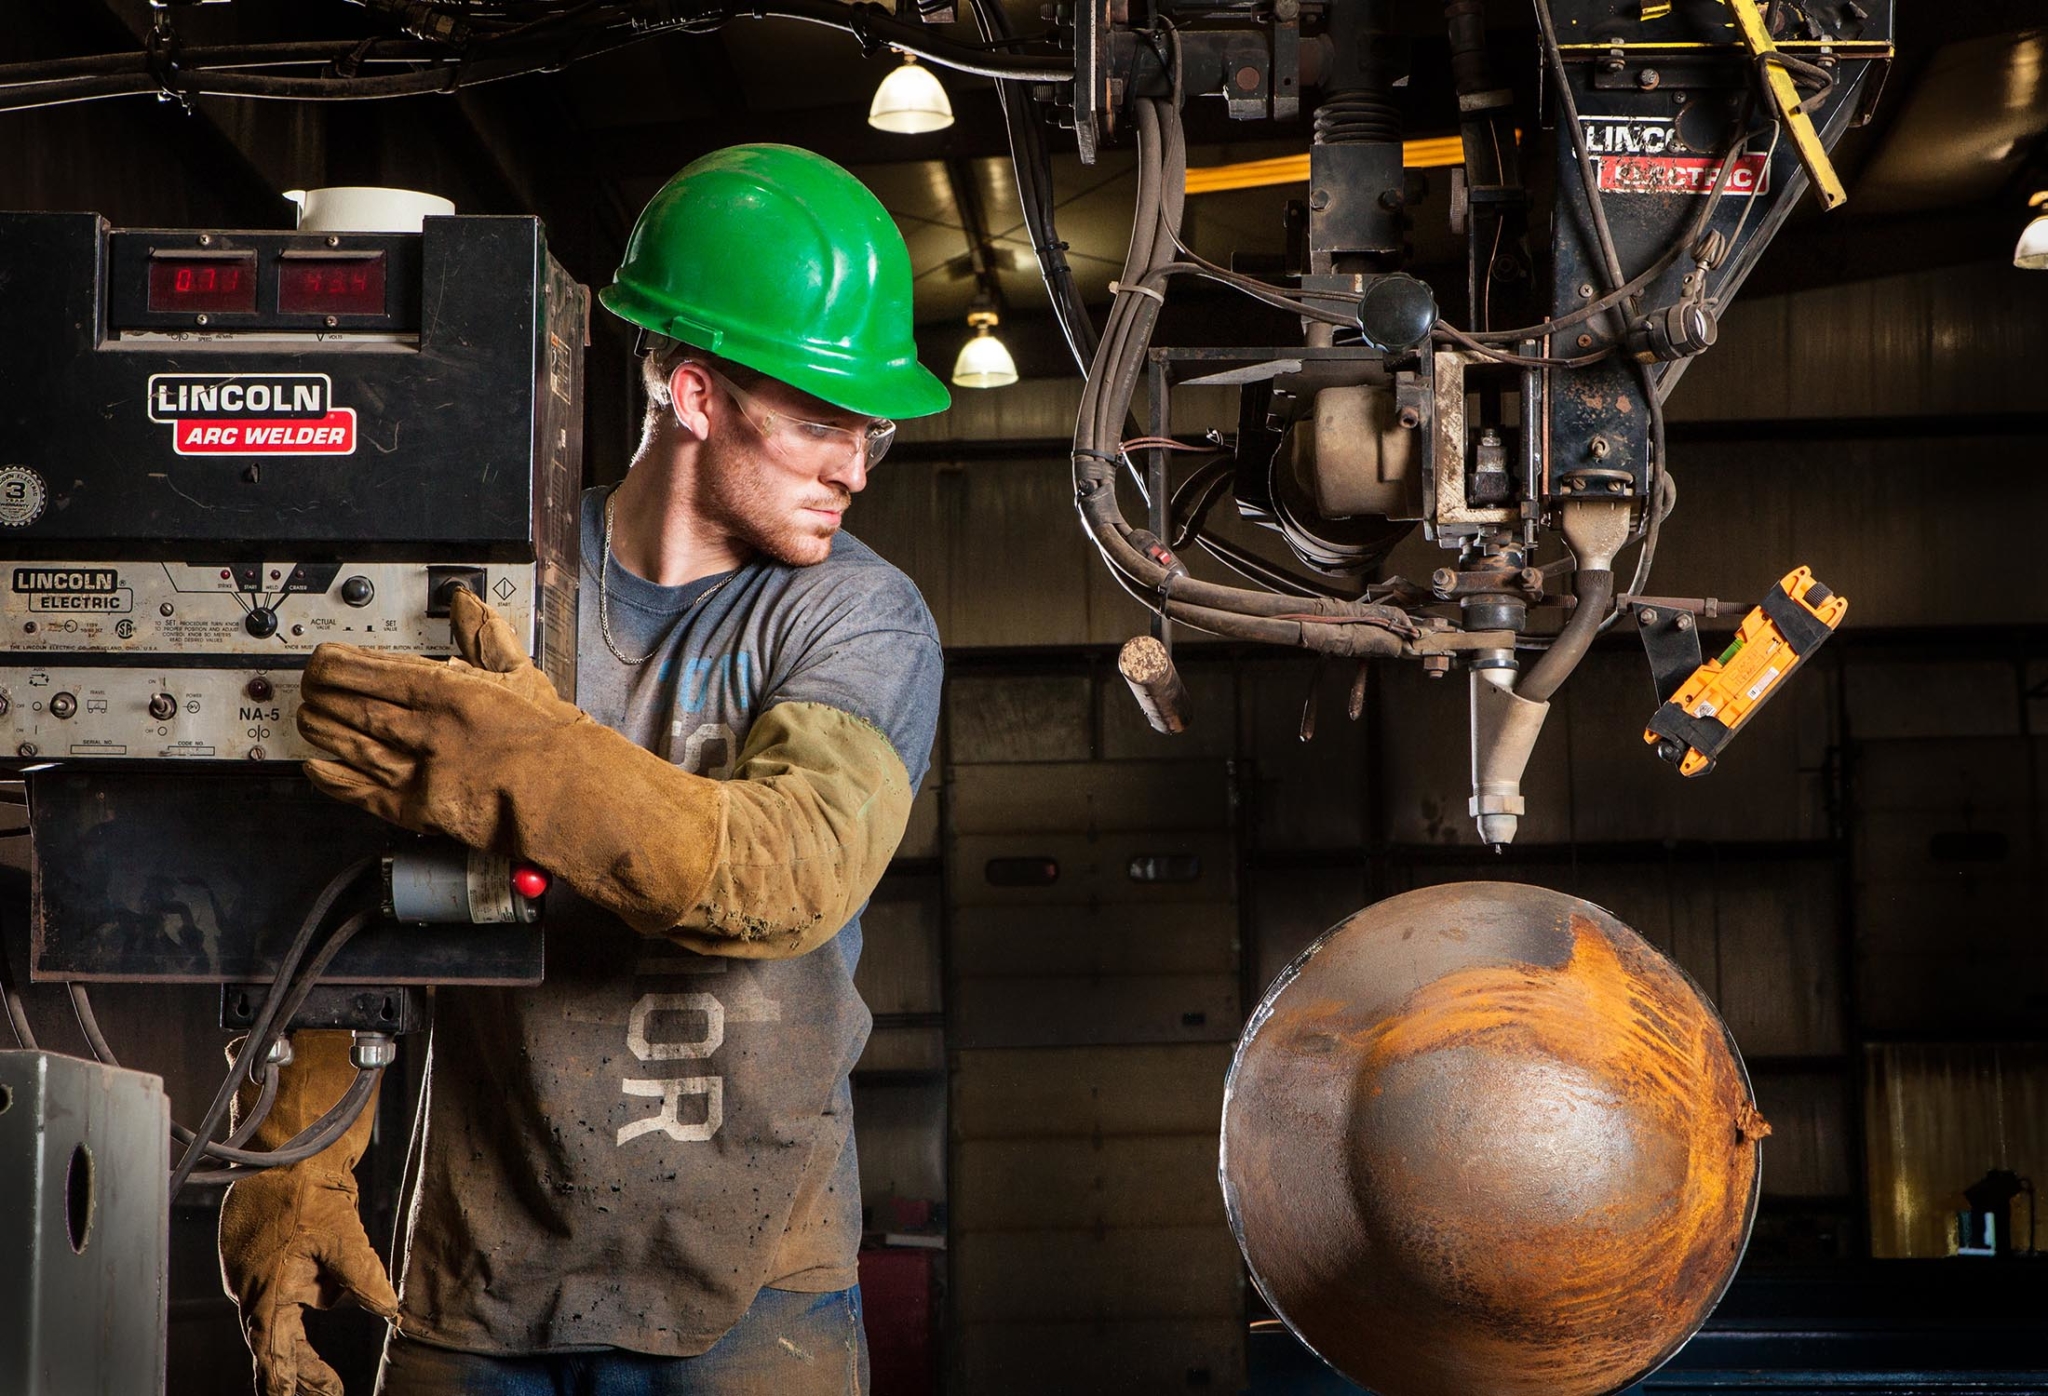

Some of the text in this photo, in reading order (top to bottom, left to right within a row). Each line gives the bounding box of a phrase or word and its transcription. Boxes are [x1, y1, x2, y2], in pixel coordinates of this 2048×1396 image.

[1586, 125, 1687, 153] LINC
[158, 385, 320, 412] LINCOLN
[184, 427, 346, 445] ARC WELDER
[6, 481, 26, 499] 3
[18, 572, 112, 590] LINCOLN
[41, 596, 120, 608] ELECTRIC
[385, 619, 397, 627] SET
[240, 707, 280, 721] NA-5
